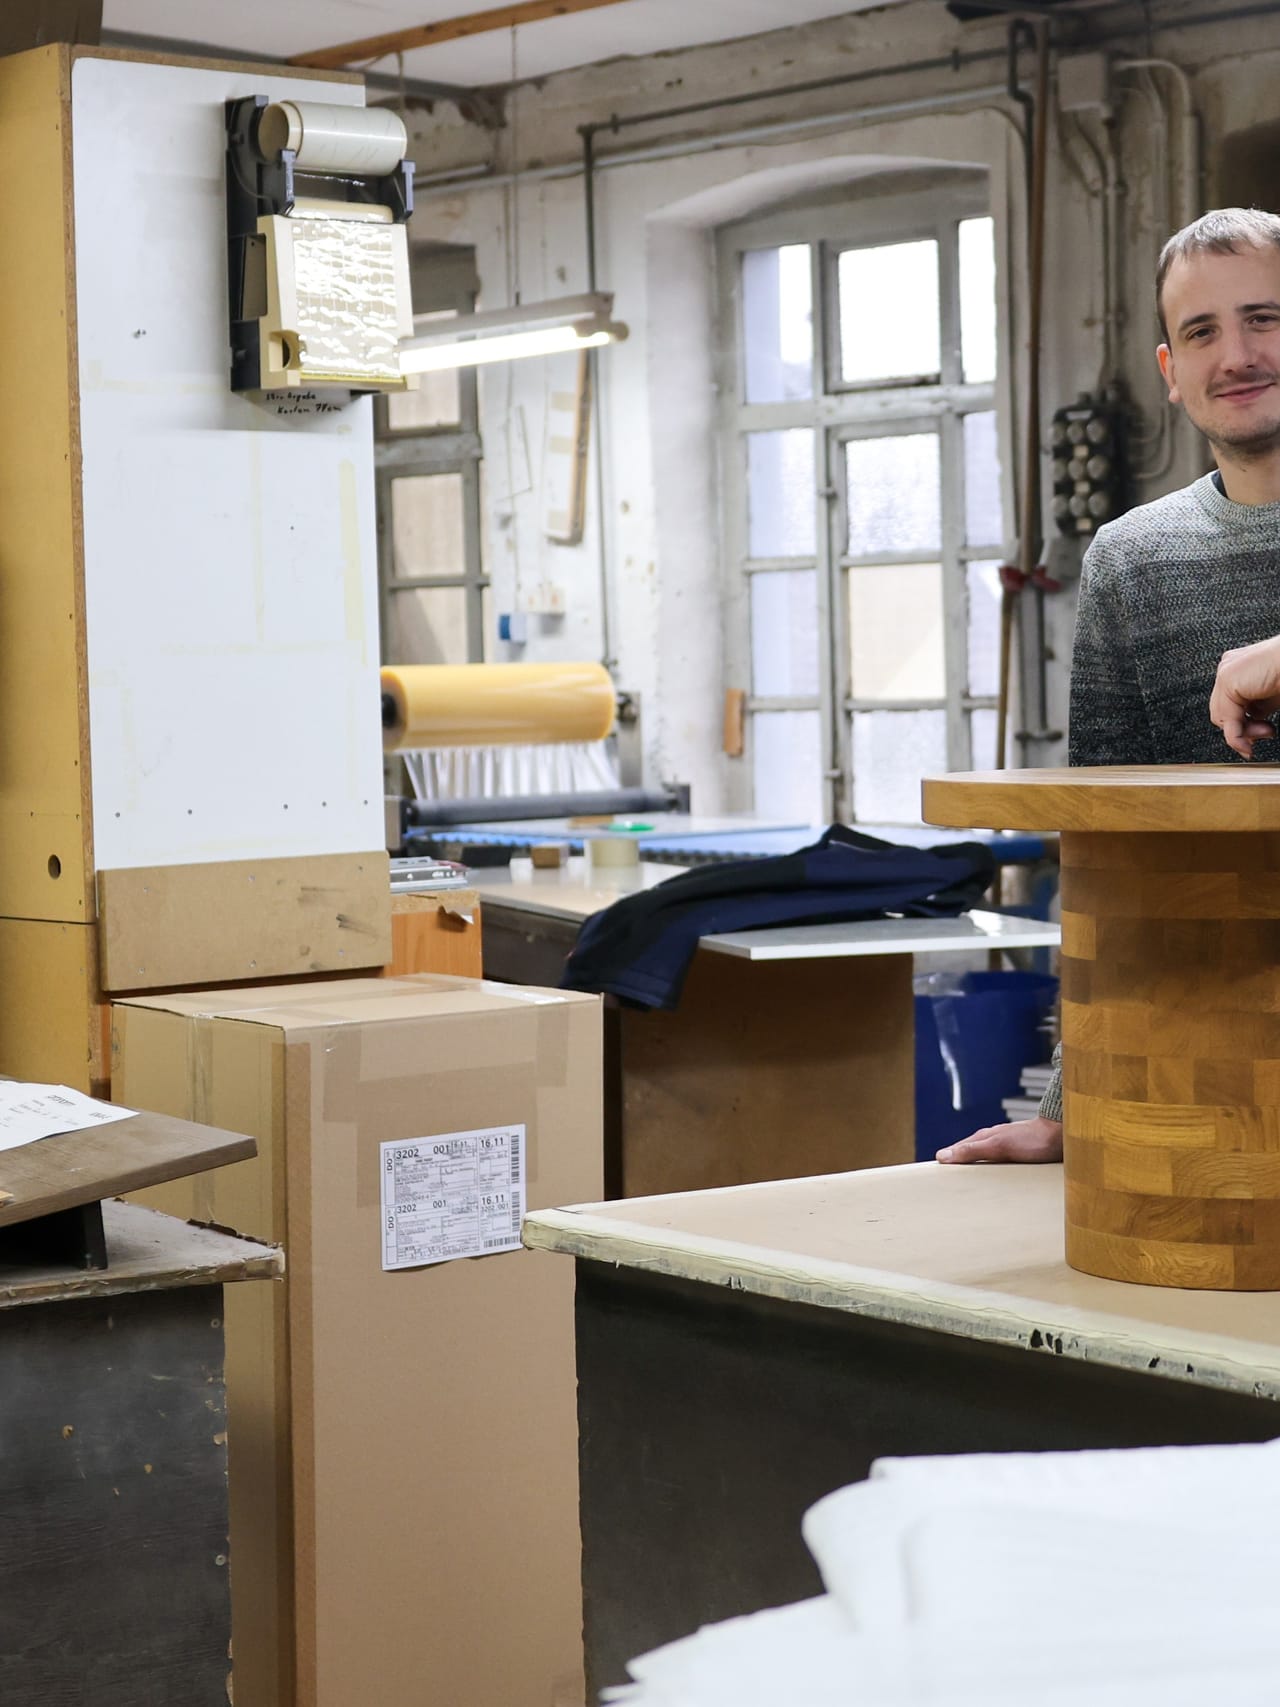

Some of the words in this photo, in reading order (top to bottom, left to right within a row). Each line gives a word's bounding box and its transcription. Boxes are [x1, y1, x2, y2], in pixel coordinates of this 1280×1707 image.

[396, 1149, 419, 1160] 3202
[433, 1144, 450, 1155] 001
[397, 1204, 417, 1214] 3202
[433, 1200, 447, 1209] 001
